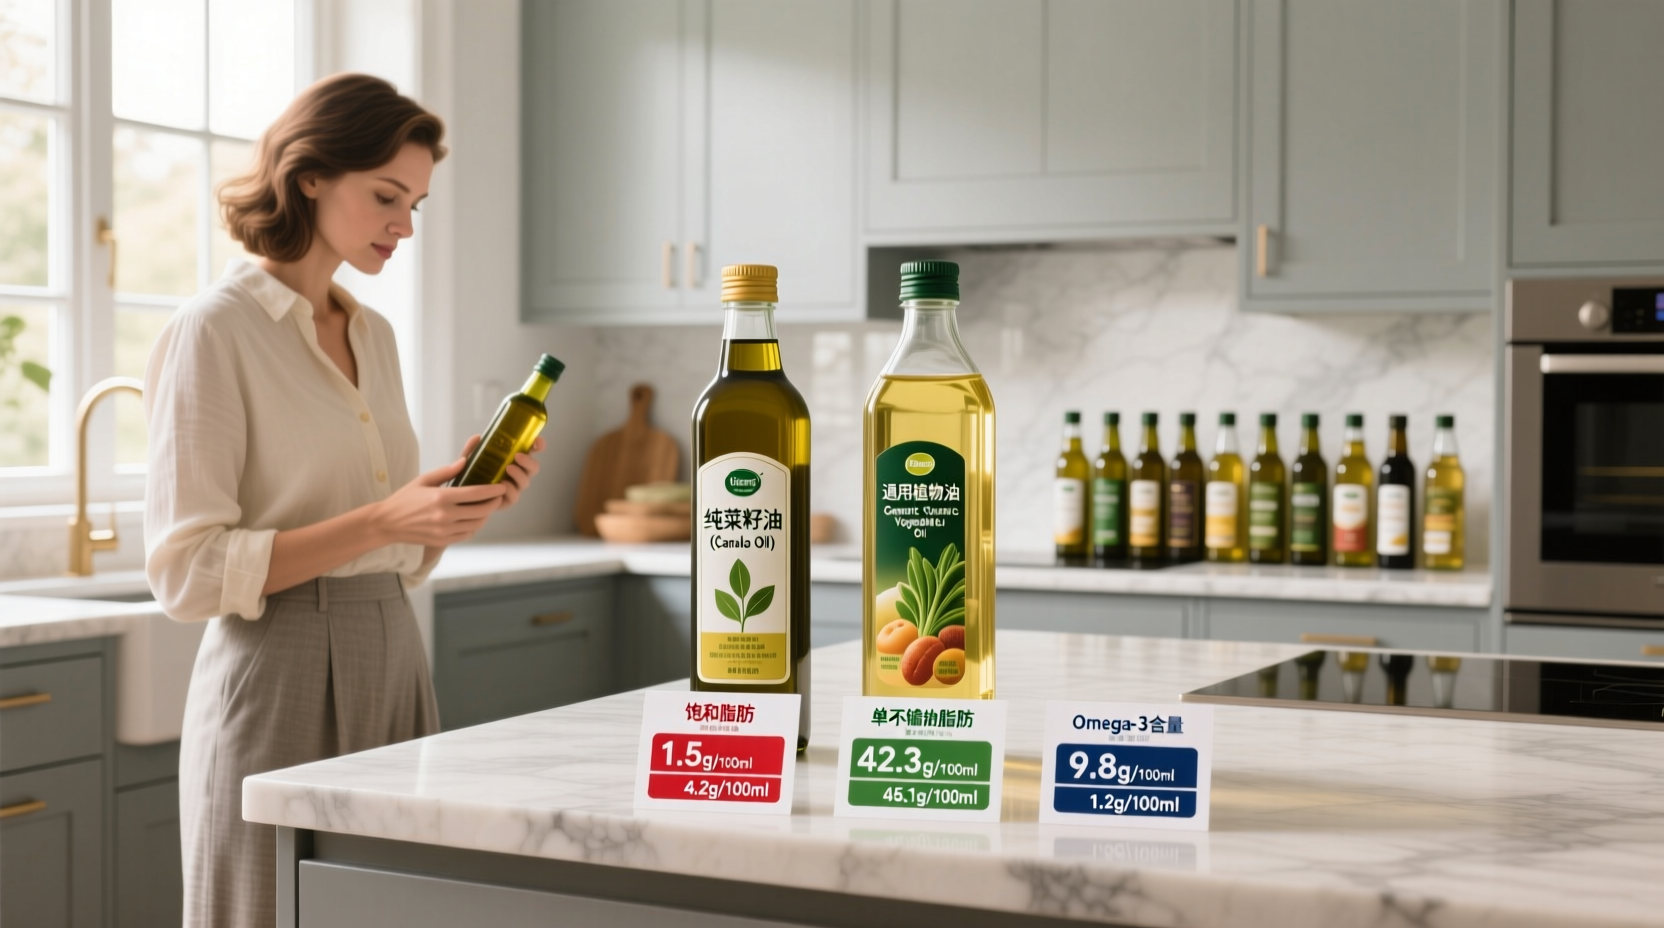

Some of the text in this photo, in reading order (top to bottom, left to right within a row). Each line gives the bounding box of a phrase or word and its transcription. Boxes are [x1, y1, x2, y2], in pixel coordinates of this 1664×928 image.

[703, 507, 782, 531] 纯菜籽油
[685, 702, 756, 723] 饱和脂肪
[661, 740, 753, 772] 1.5g/100ml
[857, 745, 978, 778] 42.3g/100ml
[1069, 751, 1175, 785] 9.8g/100ml
[683, 780, 769, 800] 4.2g/100ml
[882, 786, 978, 807] 45.1g/100ml
[1090, 794, 1179, 814] 1.2g/100ml
